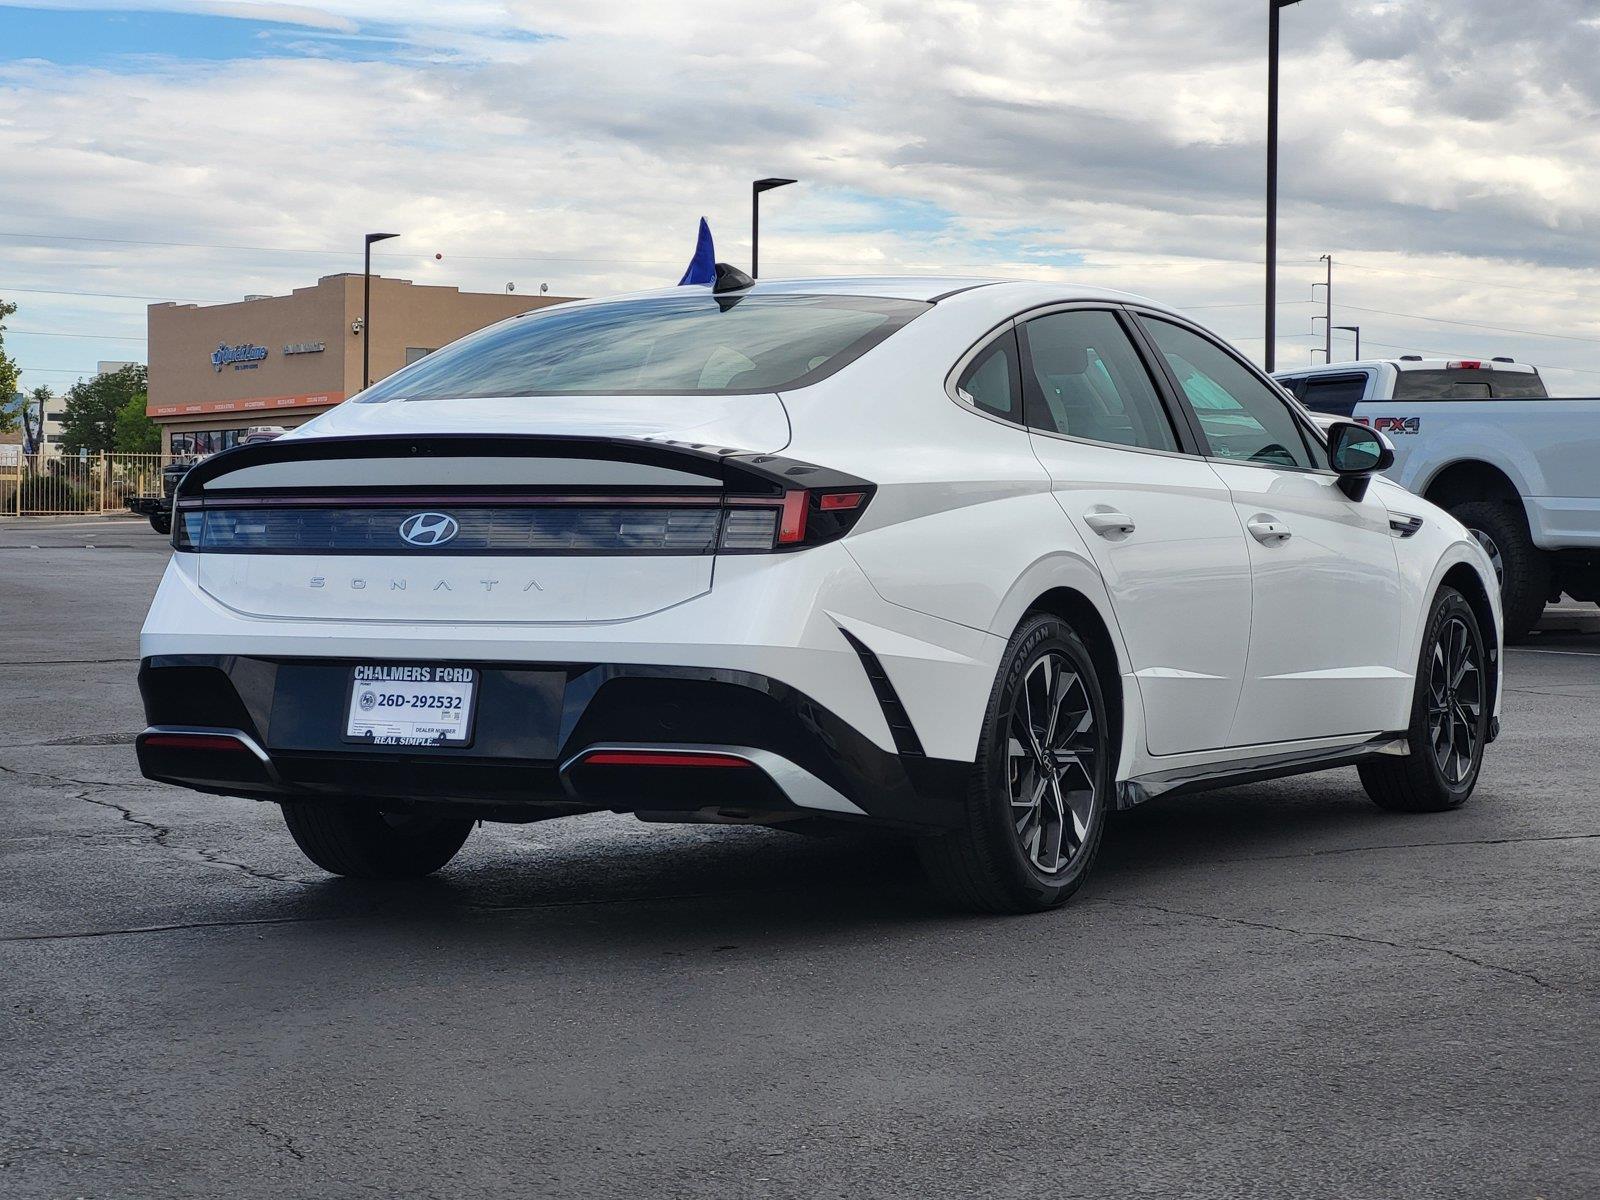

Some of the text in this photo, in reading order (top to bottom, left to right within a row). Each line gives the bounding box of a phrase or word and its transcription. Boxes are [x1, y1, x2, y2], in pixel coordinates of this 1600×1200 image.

[1375, 417, 1420, 431] FX4
[310, 576, 544, 592] SONATA
[1007, 626, 1049, 694] IRONMAN
[355, 666, 473, 682] CHALMERS FORD
[378, 694, 462, 709] 26D-292532
[374, 736, 397, 745] REAL
